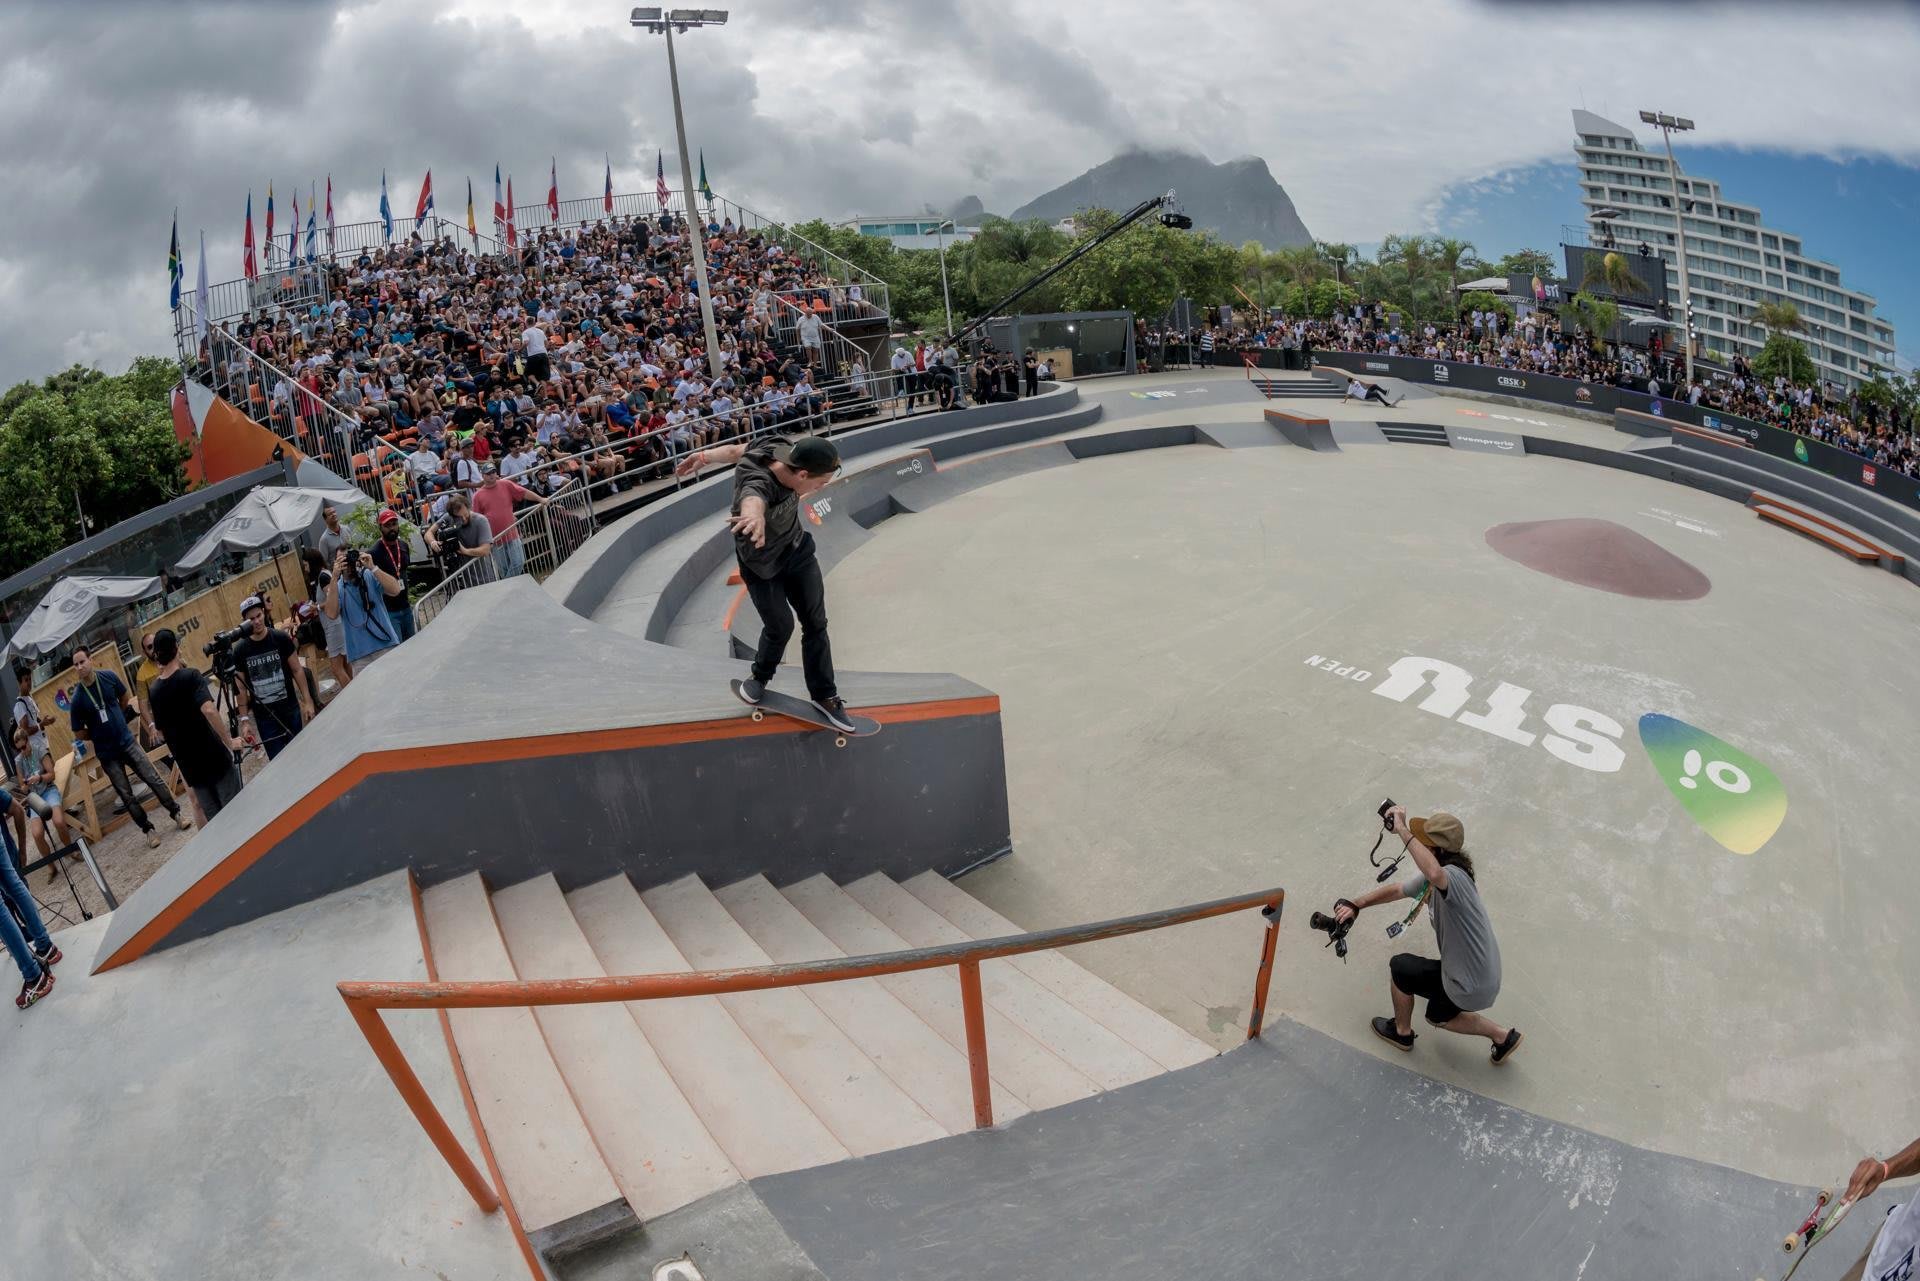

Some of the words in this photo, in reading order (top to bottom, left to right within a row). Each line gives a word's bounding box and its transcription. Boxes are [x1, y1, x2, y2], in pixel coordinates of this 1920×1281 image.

[1497, 376, 1520, 387] CBSK
[813, 498, 831, 517] STU
[258, 575, 280, 593] STU
[177, 616, 200, 637] STU
[1303, 654, 1373, 682] OPEN
[1371, 656, 1626, 773] STU
[1679, 749, 1751, 794] oi
